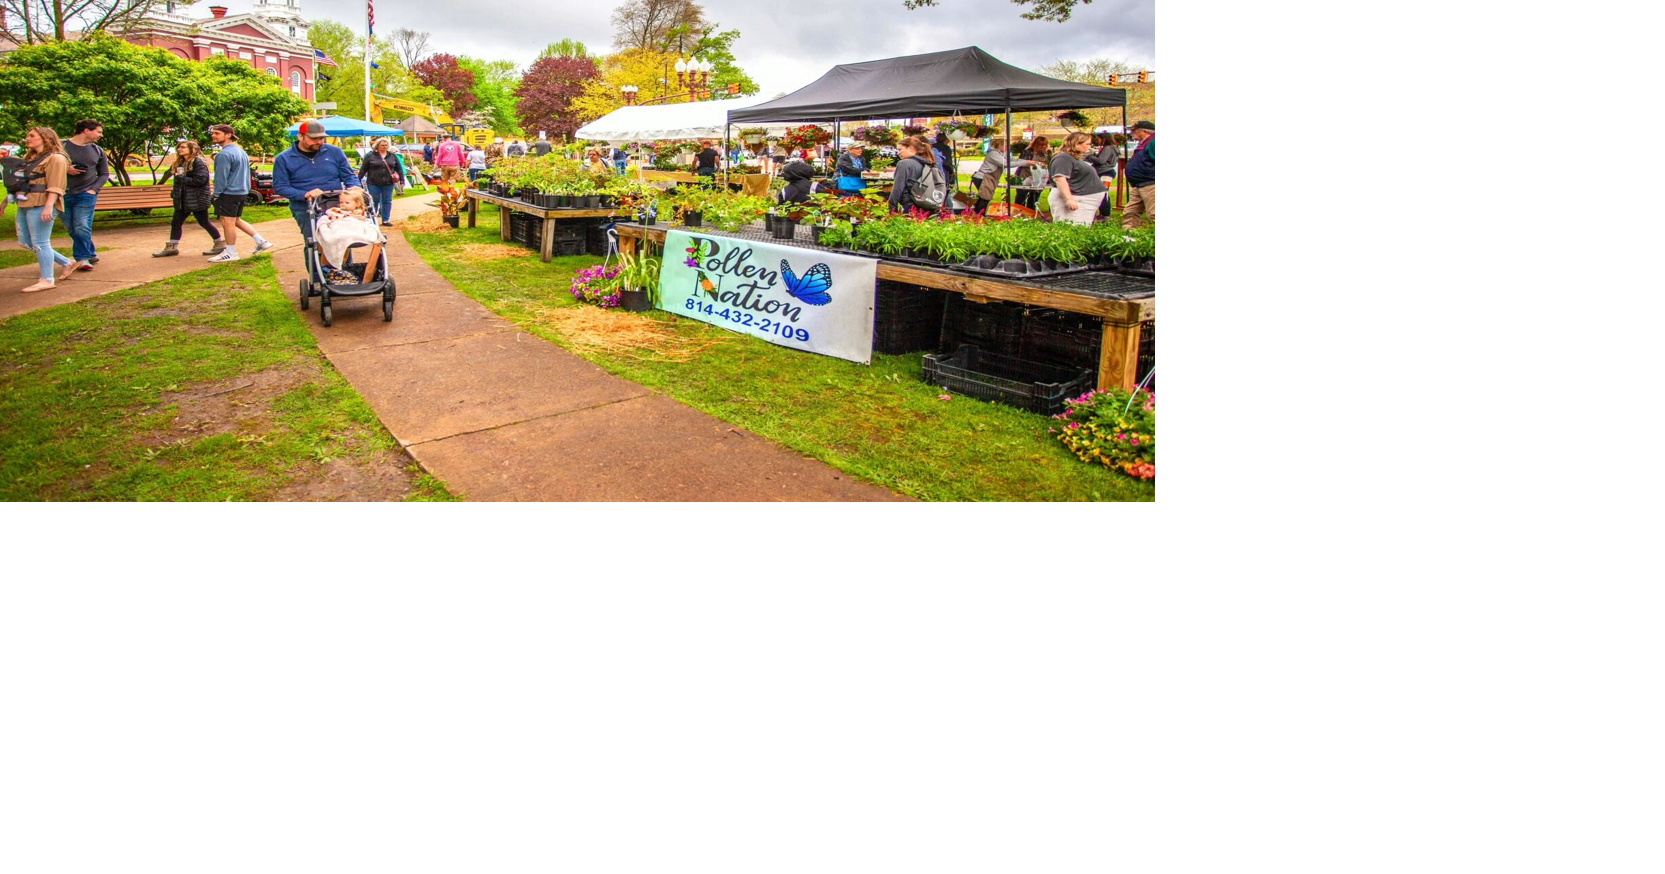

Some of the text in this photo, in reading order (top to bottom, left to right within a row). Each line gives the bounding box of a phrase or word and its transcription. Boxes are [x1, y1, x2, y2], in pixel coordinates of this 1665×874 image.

[689, 236, 777, 286] Pollen
[685, 298, 810, 342] 814-432-2109
[691, 269, 801, 323] Nation
